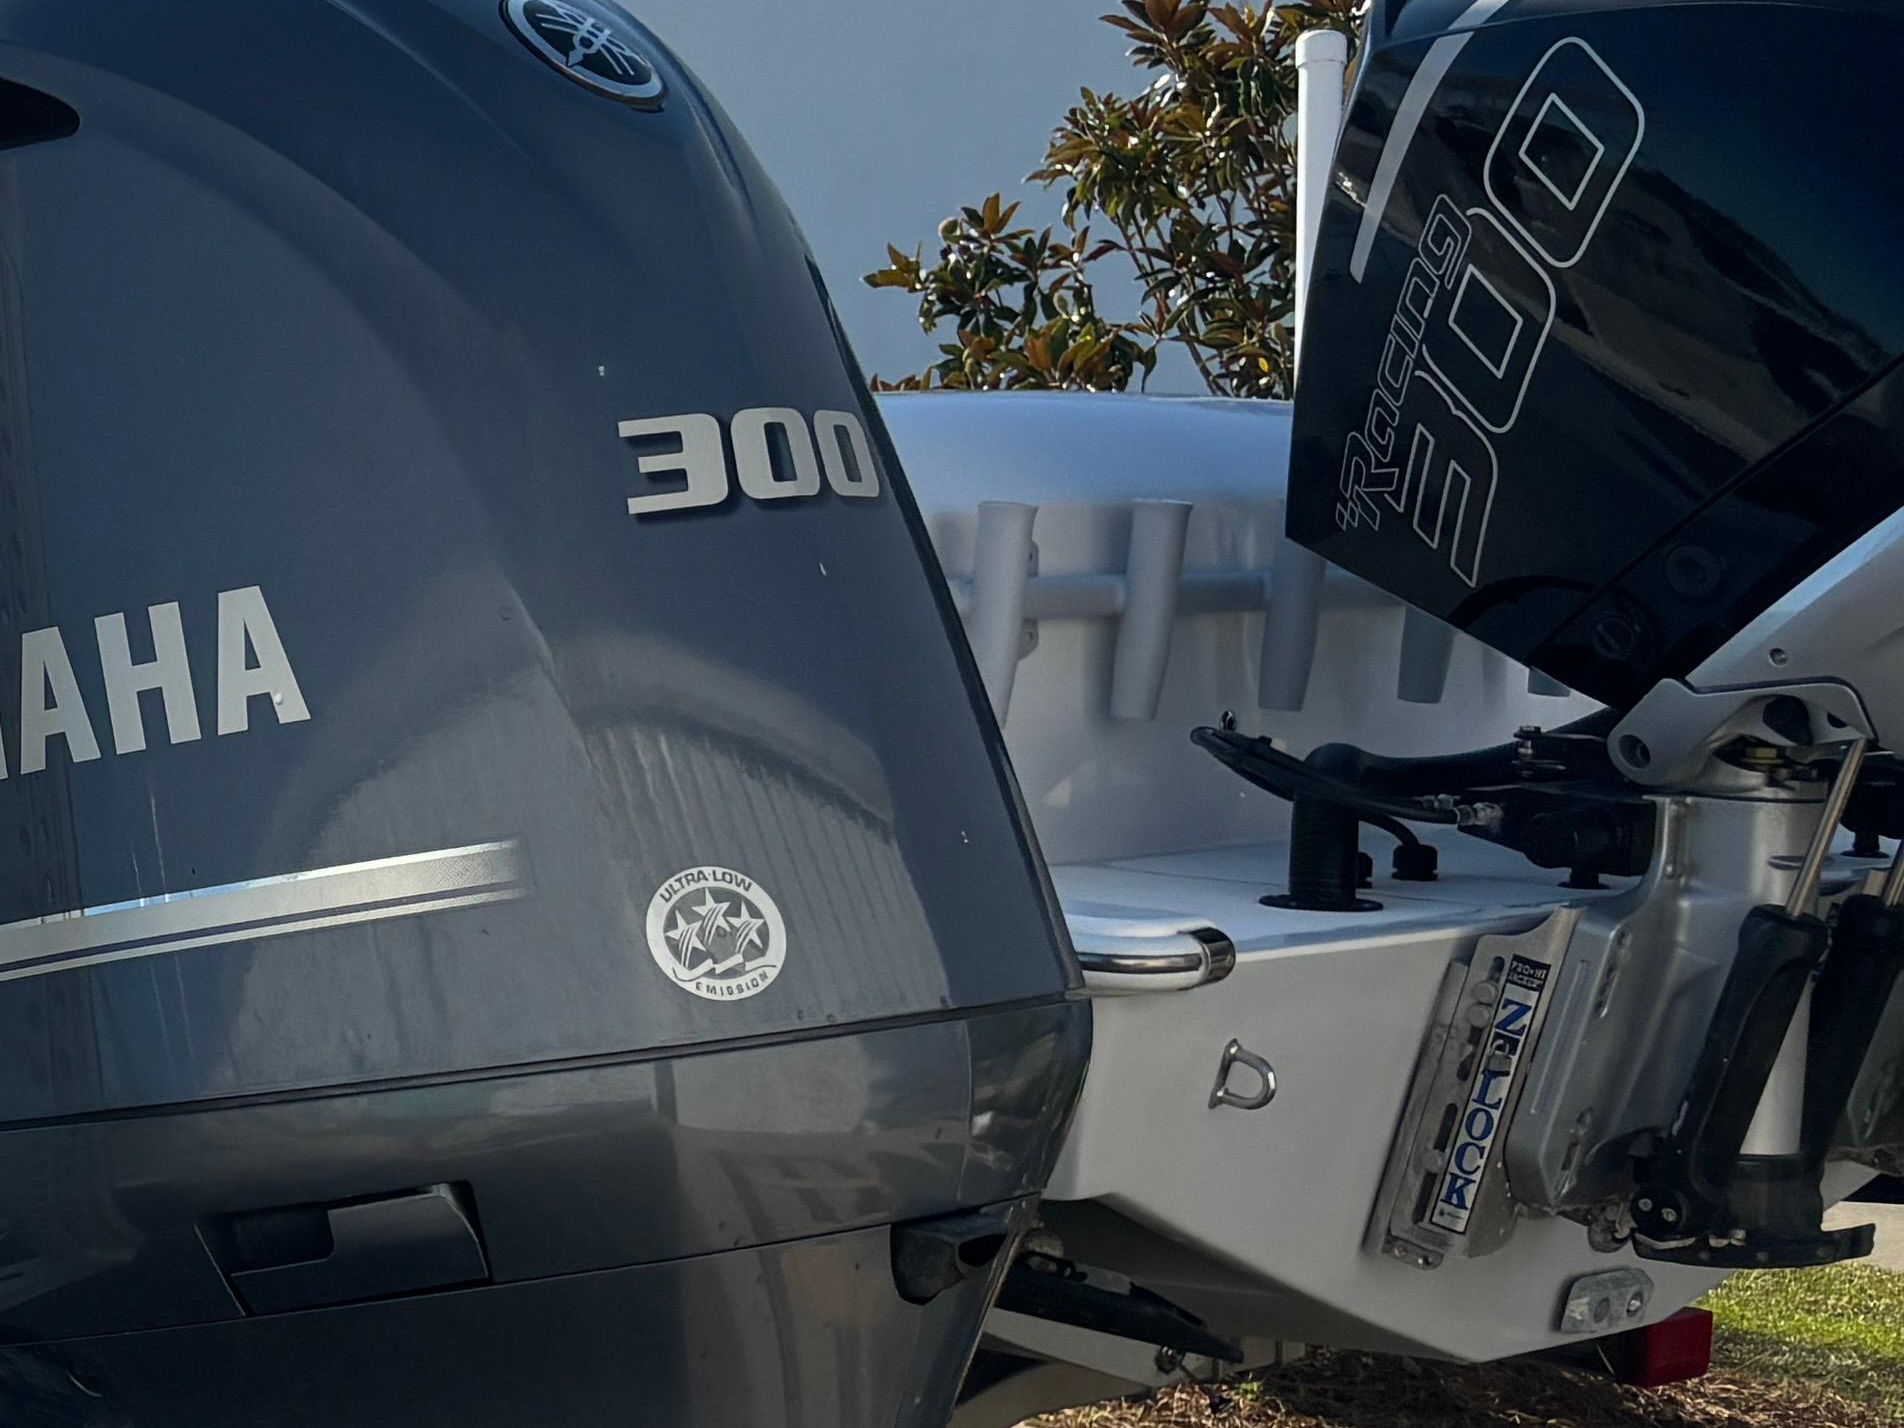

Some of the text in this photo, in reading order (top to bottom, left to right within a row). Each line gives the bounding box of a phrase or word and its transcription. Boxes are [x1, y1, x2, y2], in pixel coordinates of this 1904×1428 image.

[1384, 36, 1645, 588] 300
[618, 407, 882, 515] 300
[1440, 1069, 1511, 1211] LOCK
